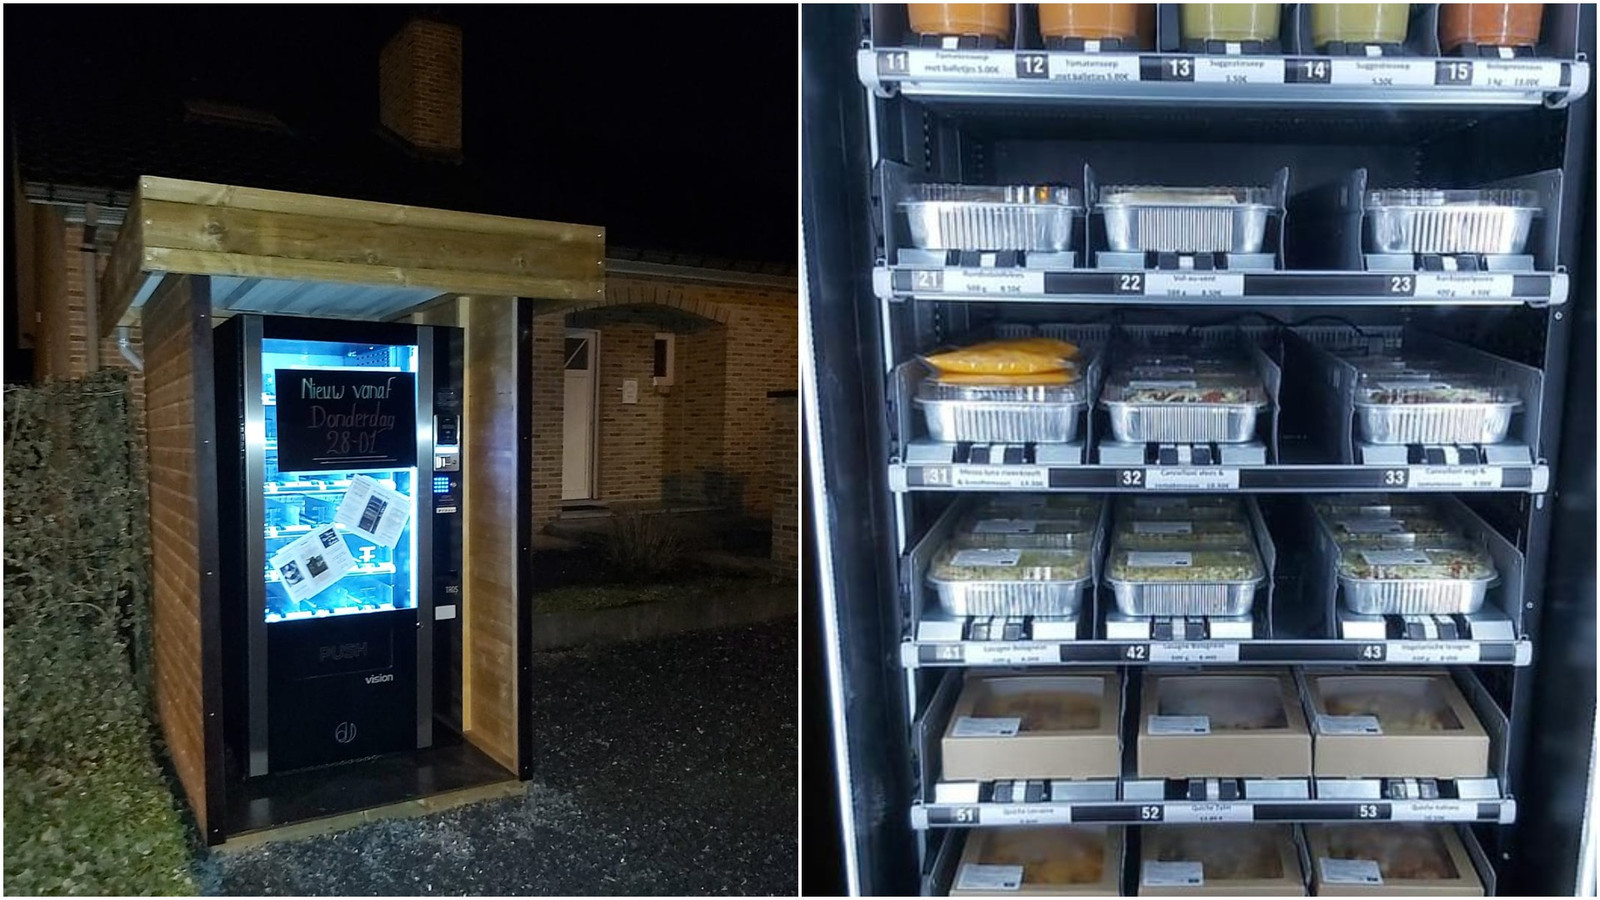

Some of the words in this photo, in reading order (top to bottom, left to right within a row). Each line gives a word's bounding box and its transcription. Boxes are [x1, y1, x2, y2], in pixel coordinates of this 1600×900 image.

[887, 53, 906, 70] 11
[1023, 56, 1045, 74] 12
[1168, 58, 1190, 77] 13
[1304, 61, 1325, 79] 14
[1448, 63, 1468, 81] 15
[919, 271, 937, 288] 21
[1121, 275, 1140, 291] 22
[1391, 276, 1411, 292] 23
[301, 377, 345, 400] Nieuw
[352, 376, 397, 399] vanaf
[306, 400, 396, 434] Donderdag
[326, 430, 378, 454] 28-01
[930, 468, 947, 484] 31
[1122, 470, 1141, 485] 32
[1386, 470, 1405, 484] 33
[320, 642, 368, 661] PUSH
[1127, 645, 1145, 659] 42
[1363, 645, 1381, 659] 43
[365, 673, 394, 685] vision
[957, 808, 973, 821] 51
[1142, 806, 1160, 819] 52
[1360, 805, 1377, 818] 53
